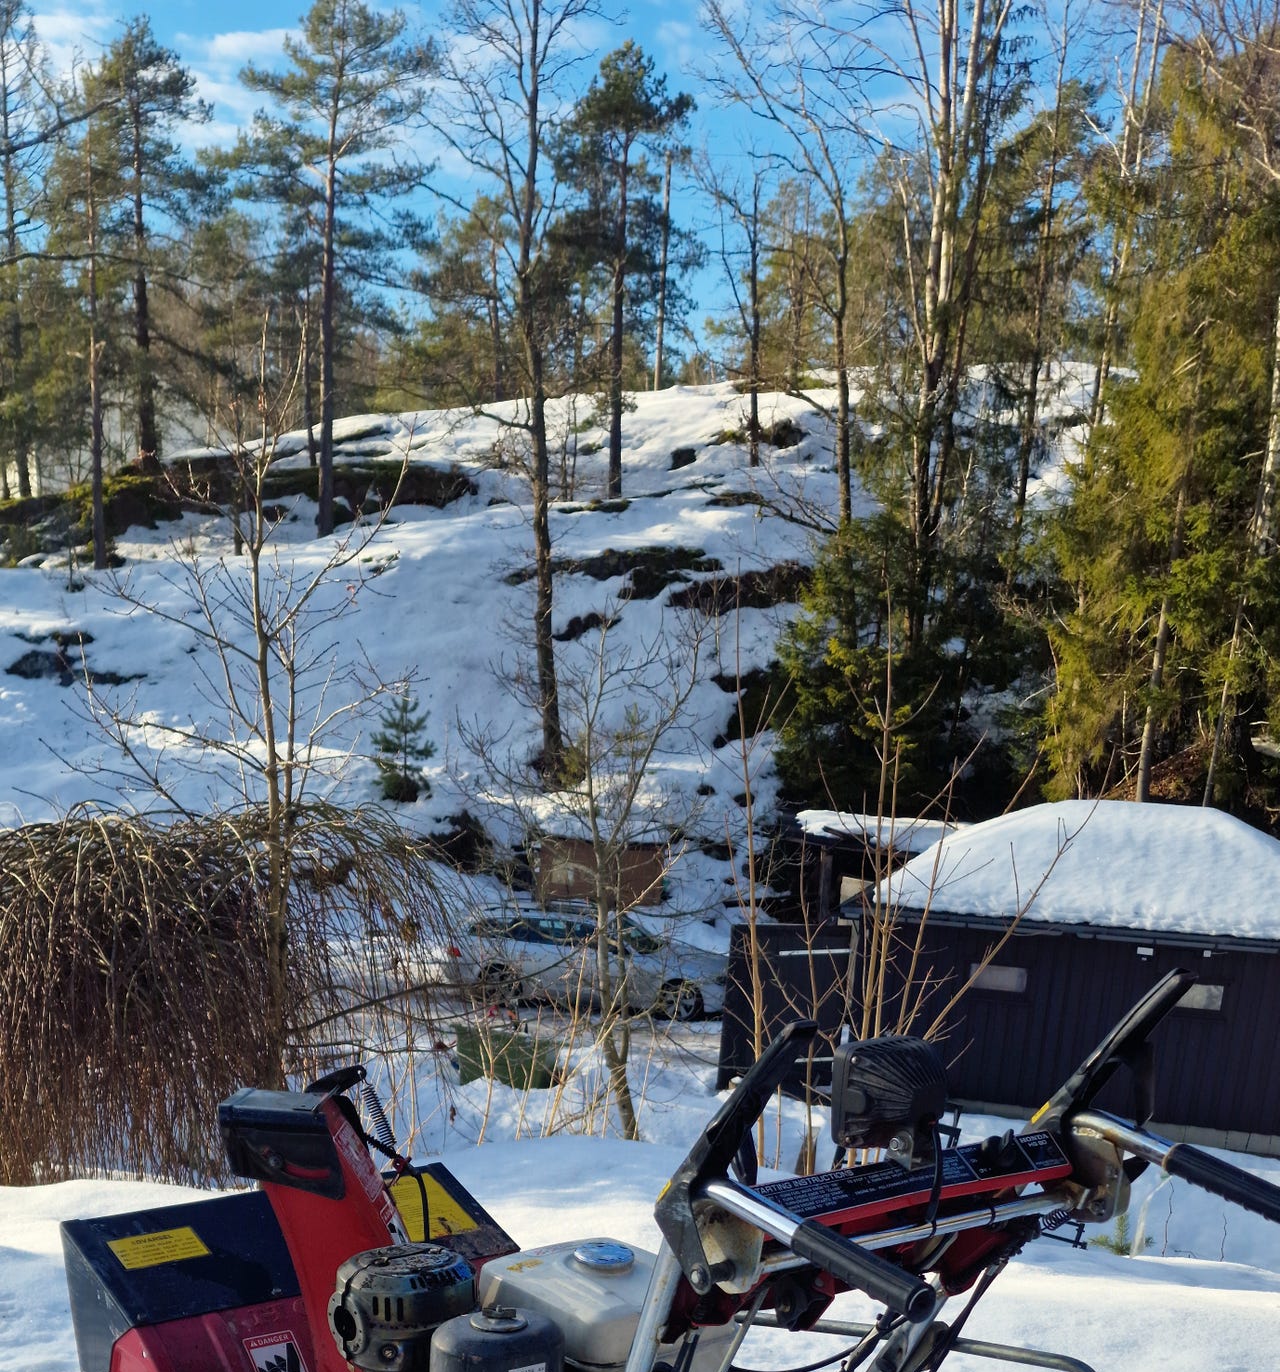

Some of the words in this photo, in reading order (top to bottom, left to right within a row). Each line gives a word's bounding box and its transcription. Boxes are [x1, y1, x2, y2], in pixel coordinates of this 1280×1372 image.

[1019, 1133, 1049, 1144] HONDA
[754, 1181, 793, 1195] TARTING
[793, 1171, 854, 1187] INSTRUCTIONS
[259, 1334, 289, 1345] DANGER
